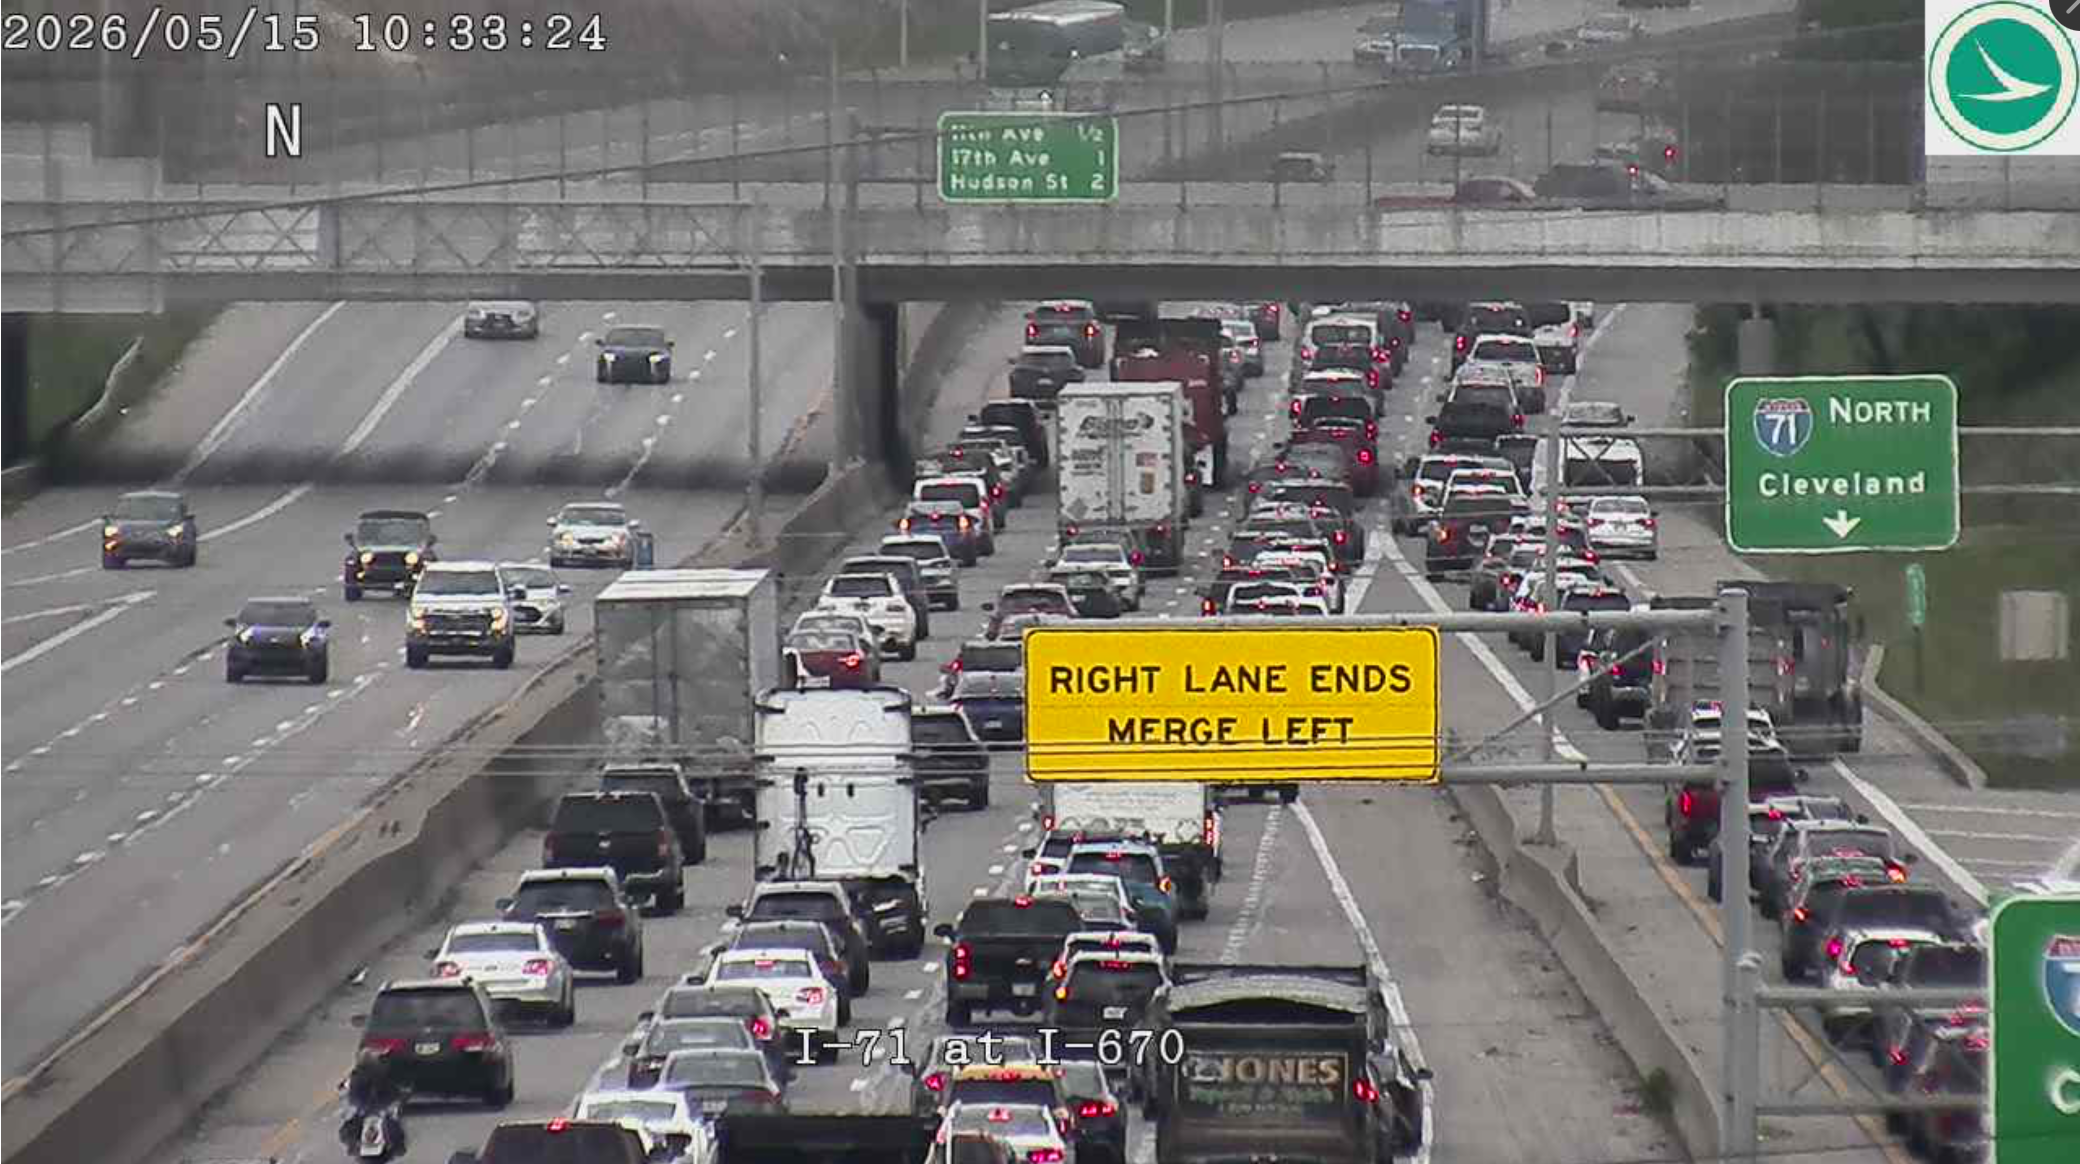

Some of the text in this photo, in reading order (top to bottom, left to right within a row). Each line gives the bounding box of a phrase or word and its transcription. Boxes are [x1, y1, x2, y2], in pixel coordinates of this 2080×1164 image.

[1001, 127, 1045, 142] Ave
[951, 148, 1105, 167] 17th Ave 1
[950, 173, 1105, 191] Hudson St 2
[1764, 414, 1797, 446] 71
[1758, 471, 1926, 497] Cleveland
[1050, 663, 1413, 694] RIGHT LANE ENDS
[1107, 717, 1355, 745] MERGE LEFT
